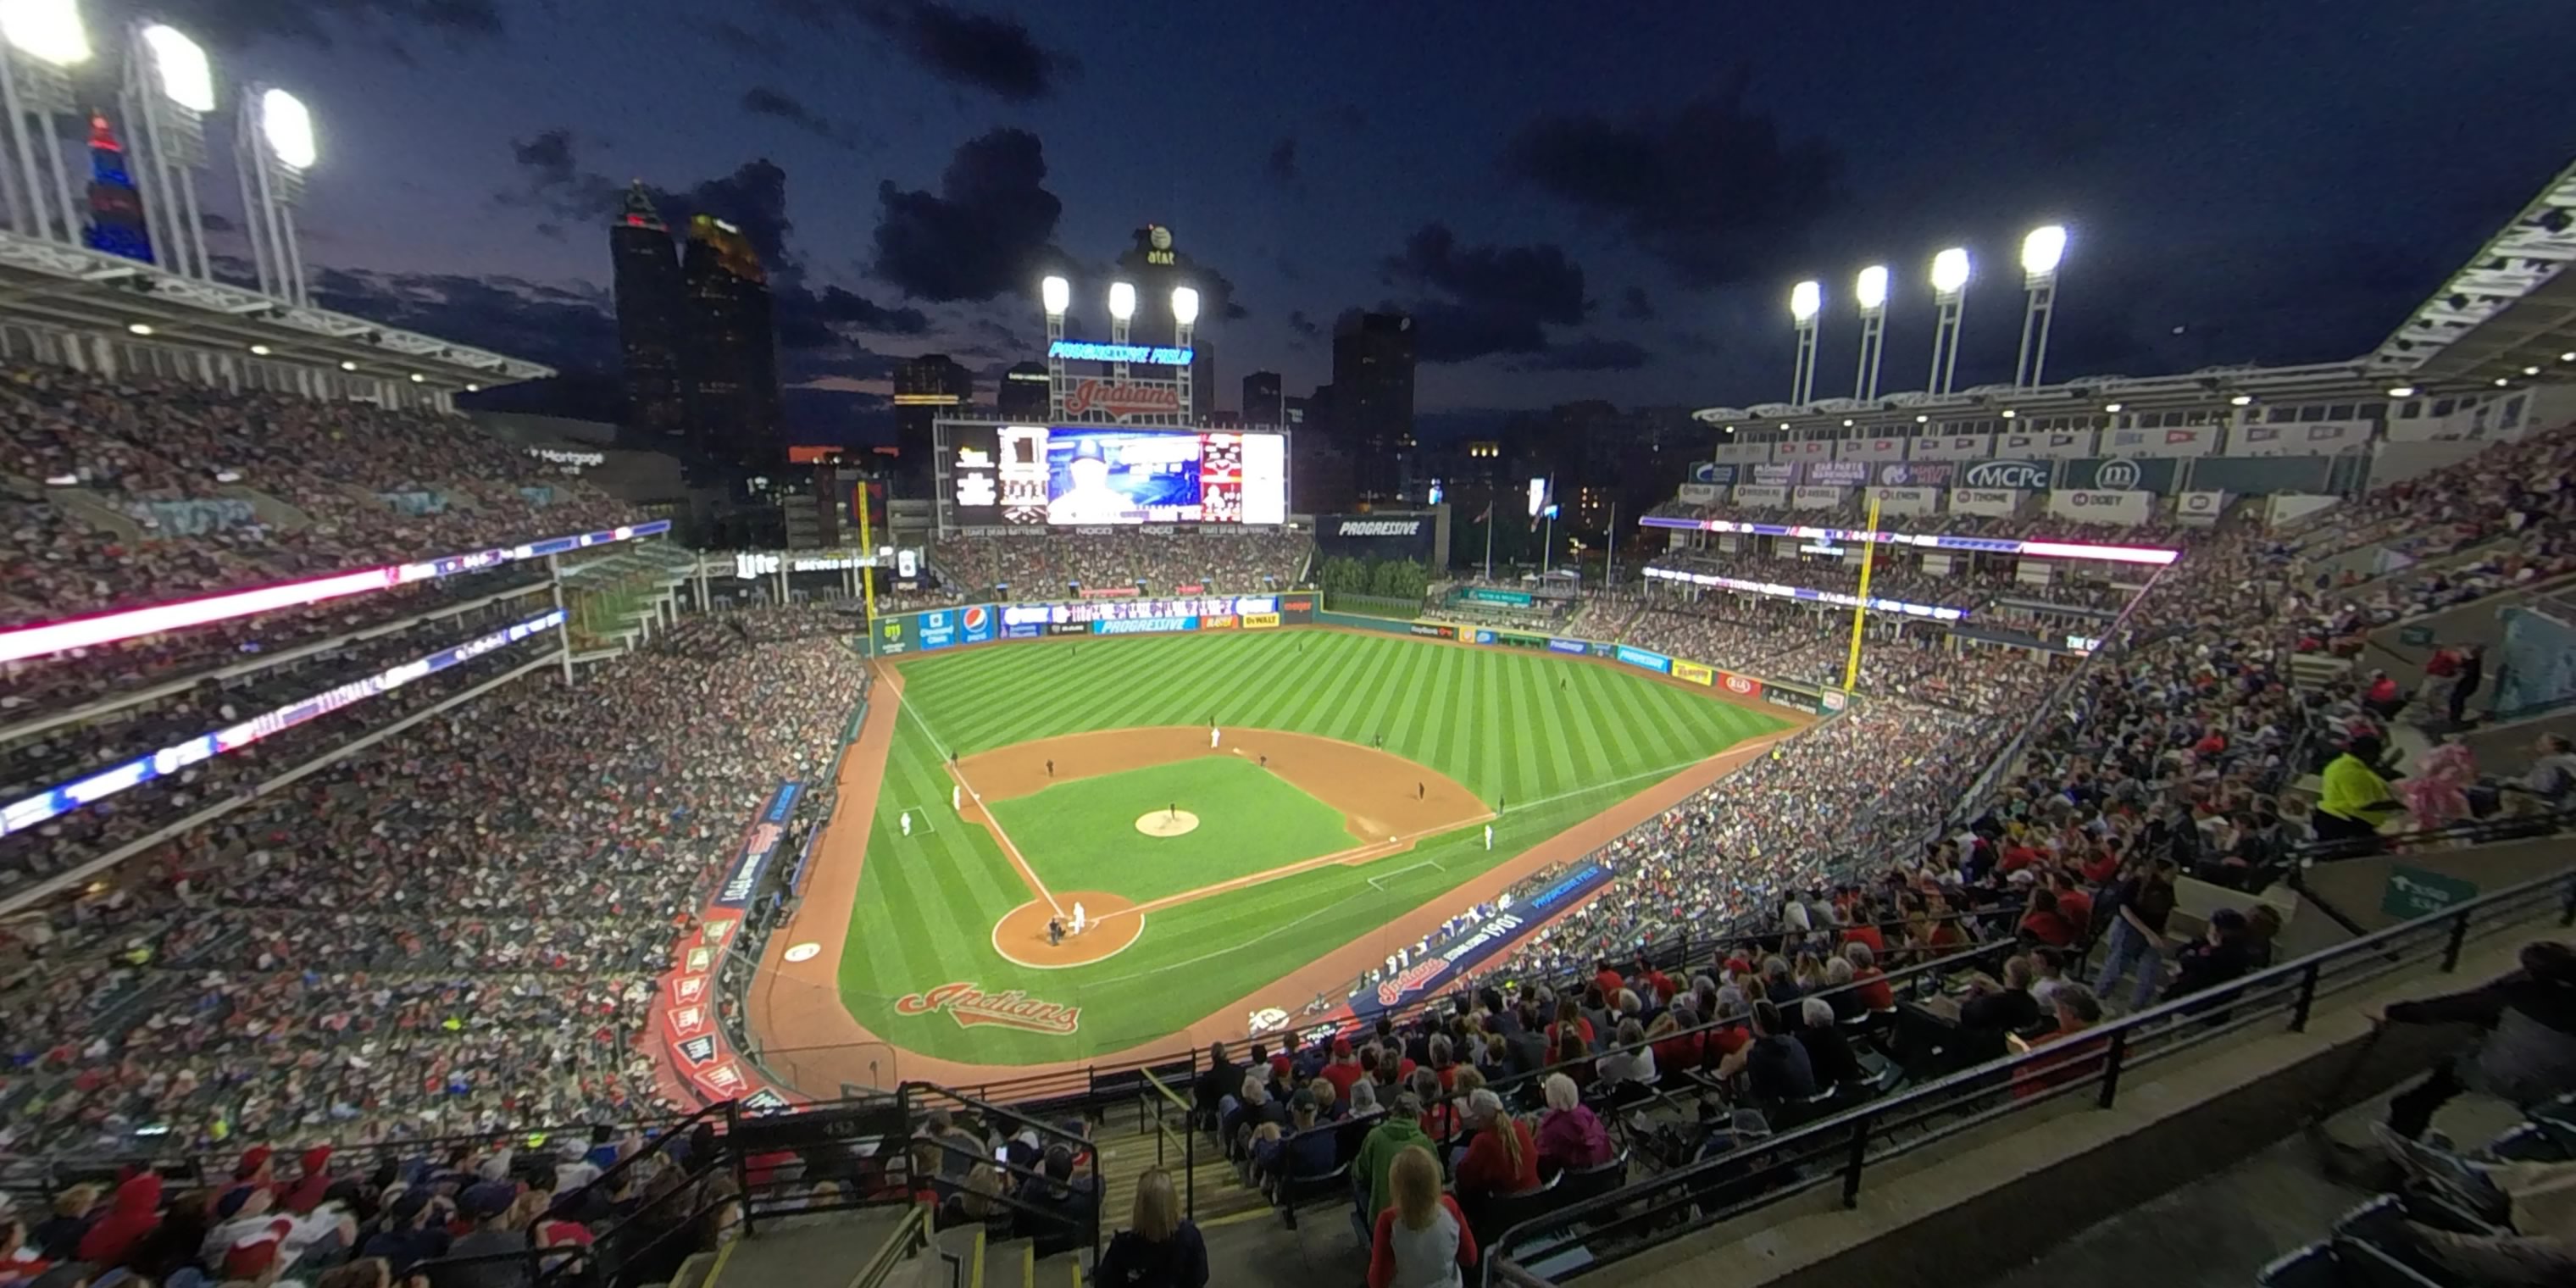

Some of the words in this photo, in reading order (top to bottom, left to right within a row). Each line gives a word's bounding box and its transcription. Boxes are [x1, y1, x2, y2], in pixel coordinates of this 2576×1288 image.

[1048, 341, 1151, 363] PROGRESSIVE
[1150, 347, 1194, 365] FIELD
[1065, 379, 1180, 419] Indians
[1979, 467, 2048, 487] MCPc
[1890, 491, 1921, 501] LEMON
[1339, 520, 1420, 536] PROGRESSIVE
[1102, 618, 1185, 634] PROGRESSIVE
[1377, 958, 1450, 1007] Indians
[1485, 913, 1524, 941] 1901
[894, 981, 1081, 1035] Indians
